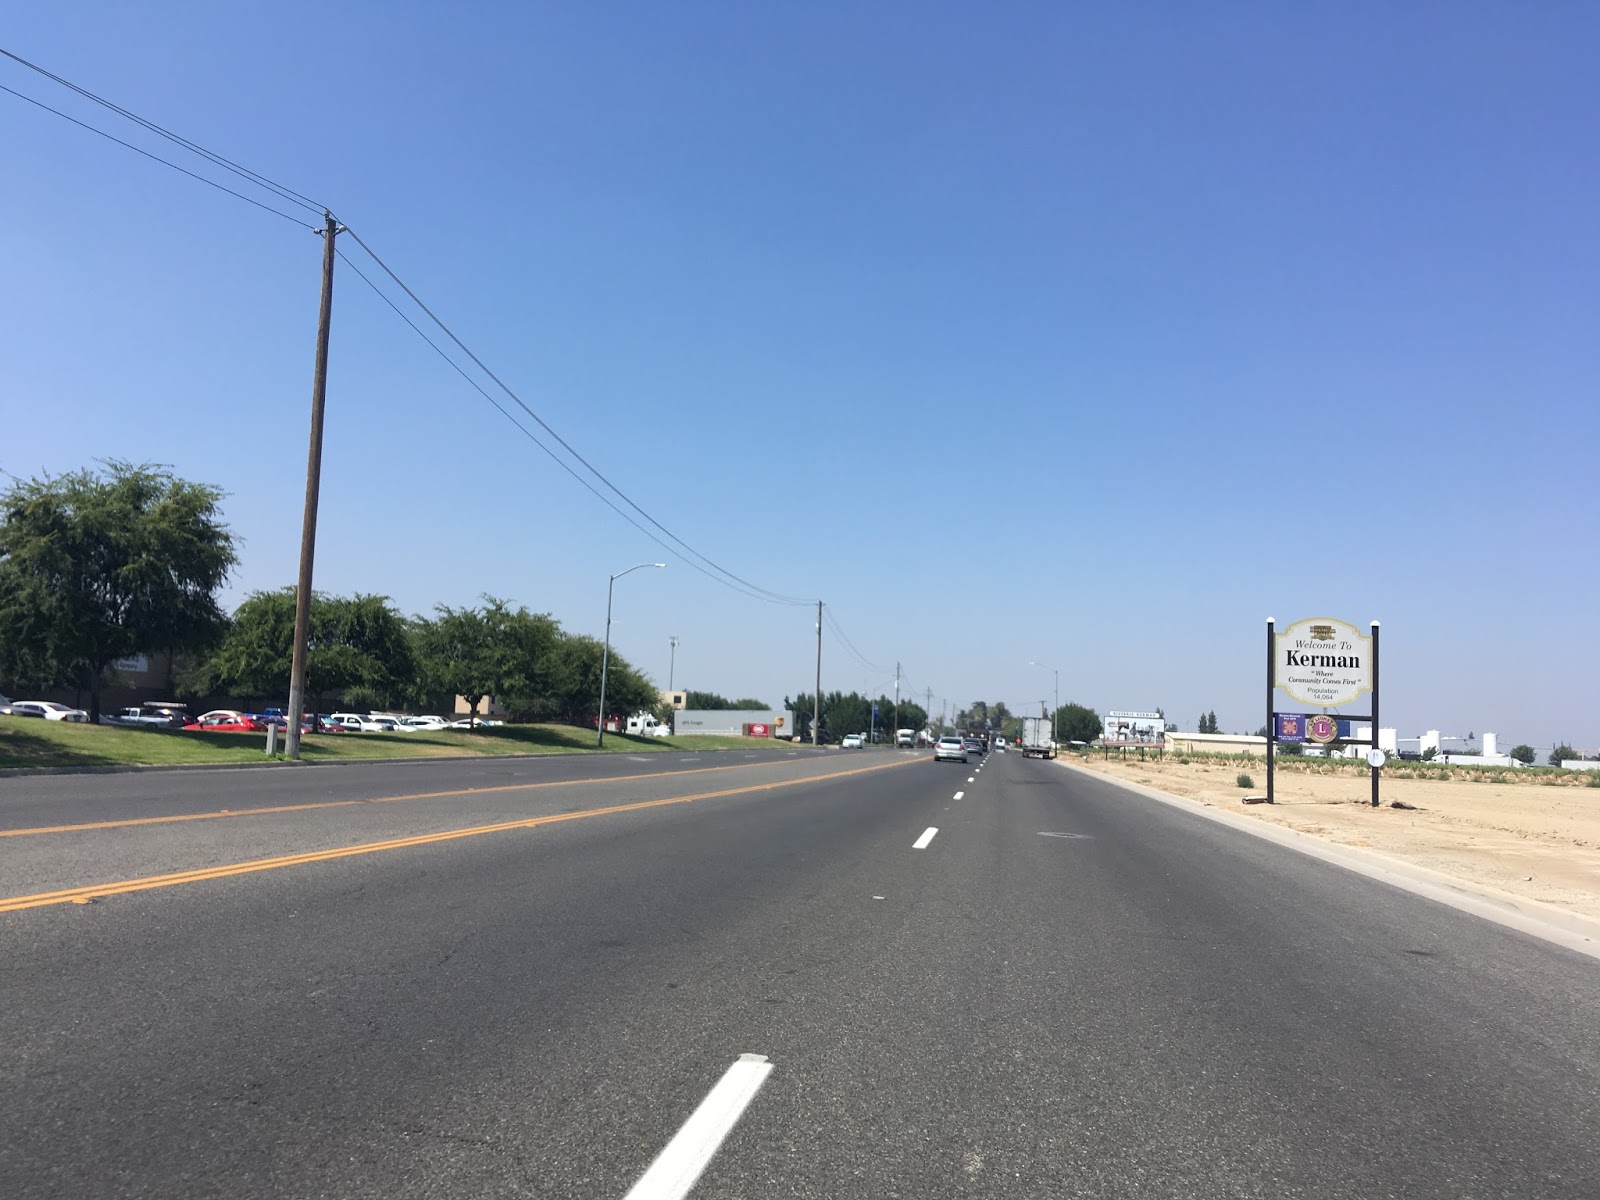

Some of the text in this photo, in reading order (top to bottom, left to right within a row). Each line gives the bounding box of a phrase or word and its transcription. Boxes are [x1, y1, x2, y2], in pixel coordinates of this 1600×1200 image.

[1296, 640, 1352, 650] Welcome To
[1286, 650, 1360, 668] Kerman
[1288, 676, 1321, 685] Community
[1307, 687, 1339, 695] Population
[1319, 723, 1326, 733] L
